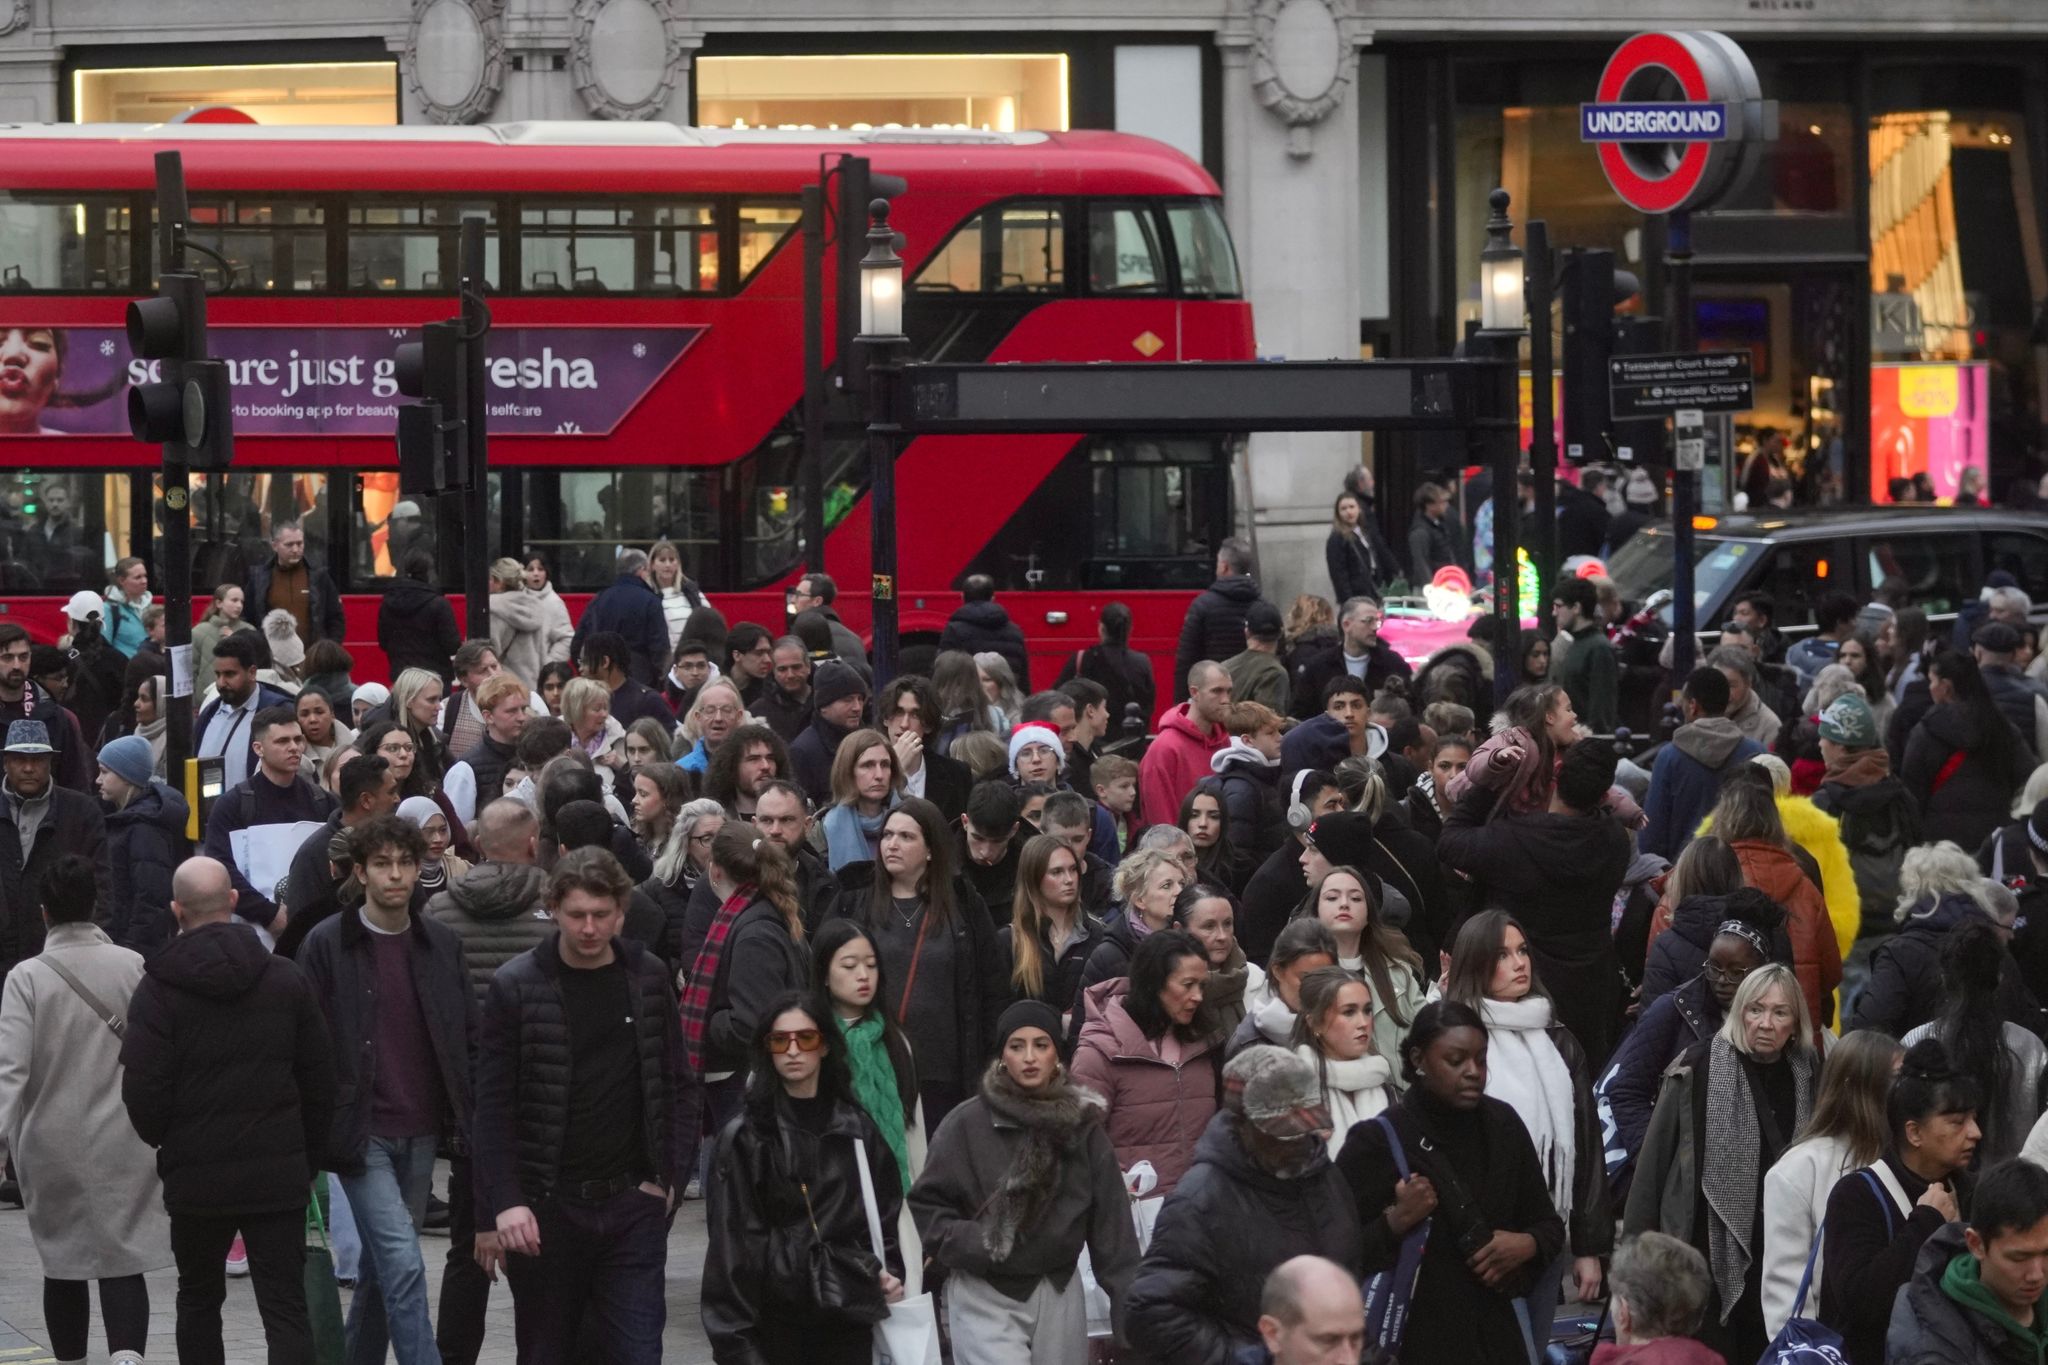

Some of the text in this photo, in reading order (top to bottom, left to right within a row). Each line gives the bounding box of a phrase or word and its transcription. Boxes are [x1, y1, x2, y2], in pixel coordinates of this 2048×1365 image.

[1587, 110, 1721, 133] UNDERGROUND
[281, 349, 365, 397] just
[1675, 359, 1702, 370] Court
[252, 403, 304, 420] booking
[306, 406, 333, 419] app
[335, 403, 353, 417] for
[356, 403, 399, 420] beauty
[491, 403, 542, 417] selfcare
[1365, 1290, 1376, 1309] MADE
[1392, 1304, 1405, 1342] MATERIALS
